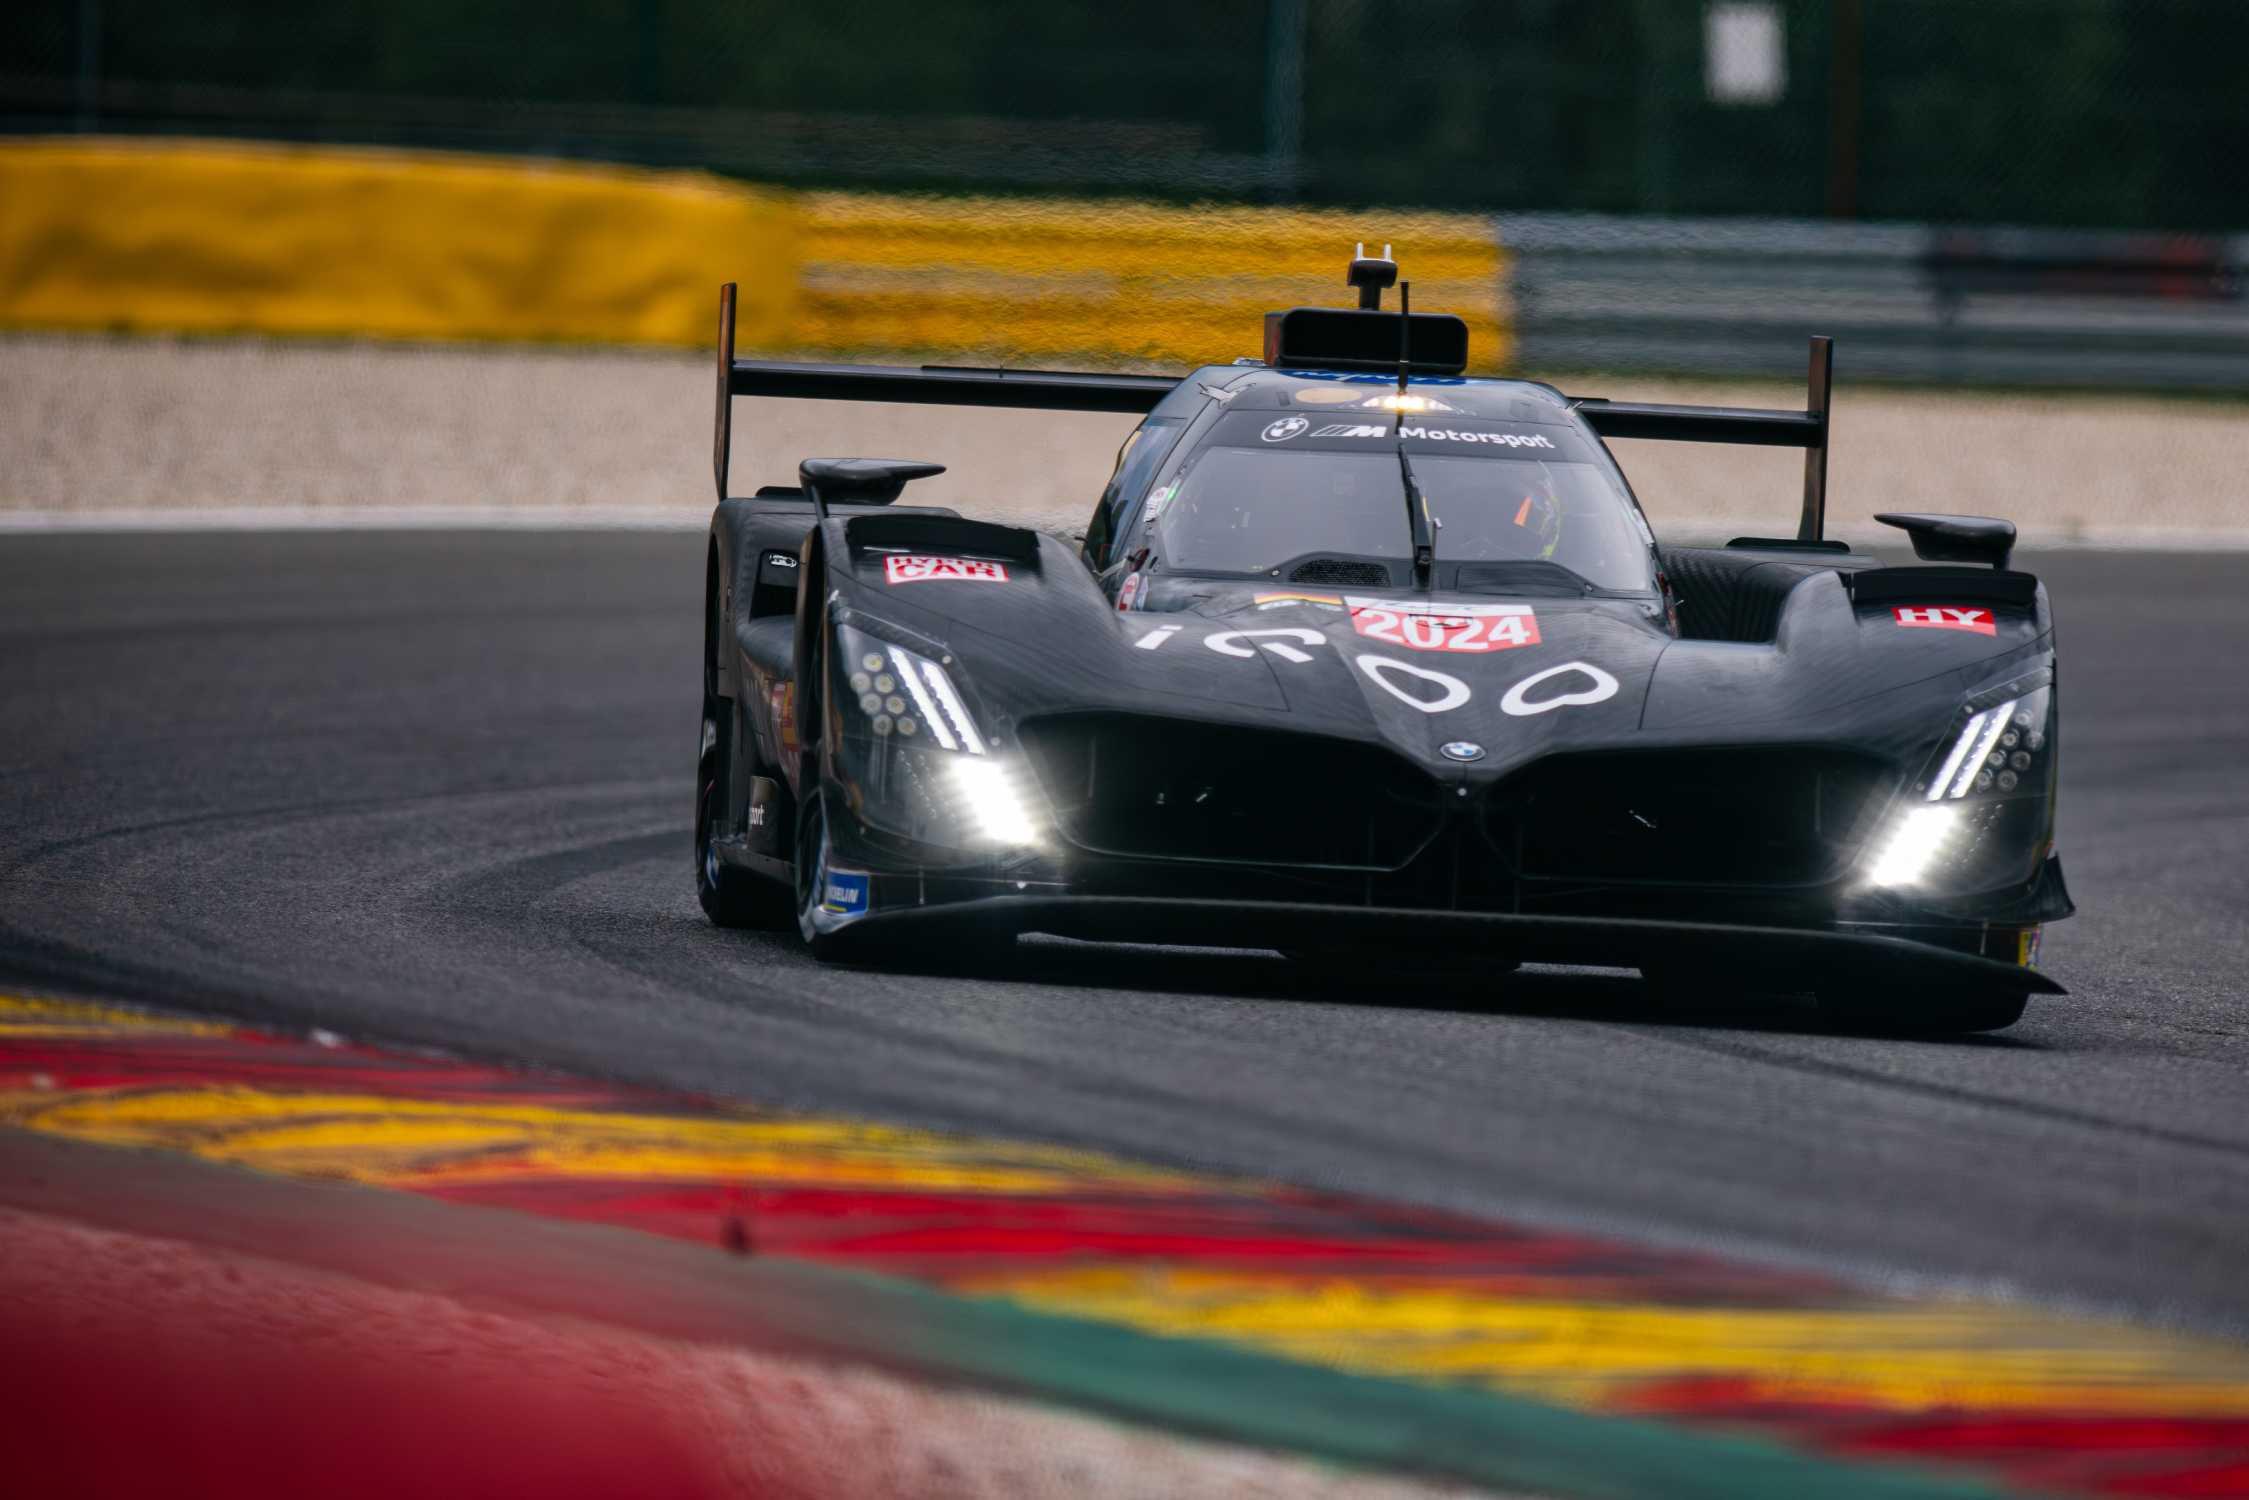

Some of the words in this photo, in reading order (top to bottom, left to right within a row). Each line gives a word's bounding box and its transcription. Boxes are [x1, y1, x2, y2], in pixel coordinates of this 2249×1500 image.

[1400, 427, 1556, 449] Motorsport
[895, 564, 996, 578] CAR
[1898, 608, 1985, 627] HY
[1359, 609, 1531, 649] 2024
